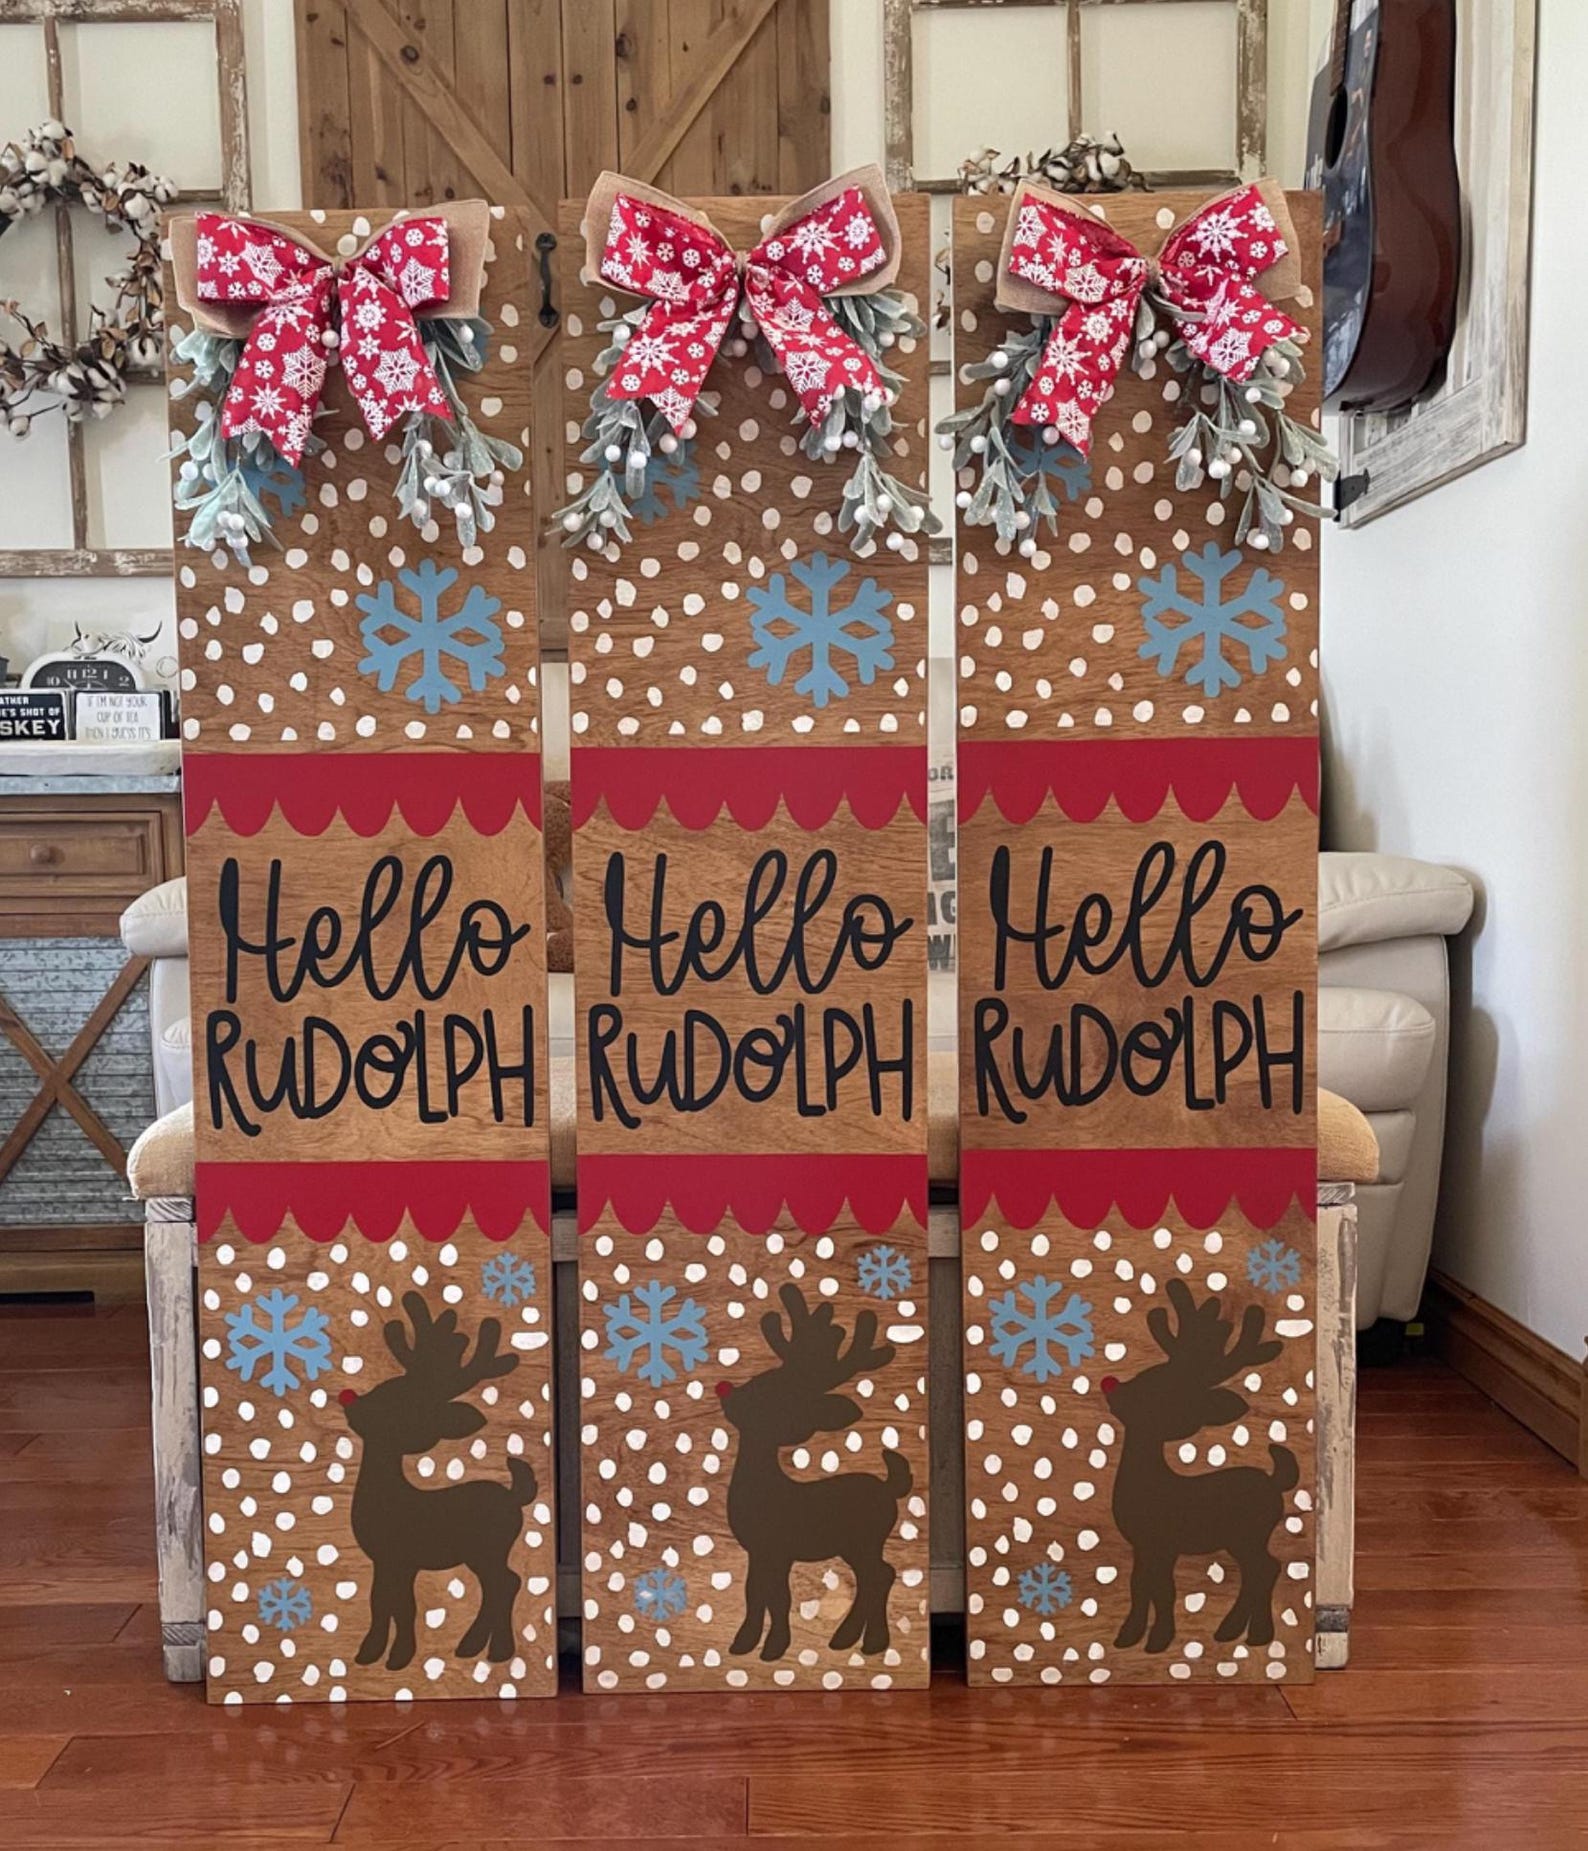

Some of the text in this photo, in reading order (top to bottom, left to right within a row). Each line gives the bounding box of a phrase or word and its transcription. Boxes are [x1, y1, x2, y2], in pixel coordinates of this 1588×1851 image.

[20, 707, 44, 717] SHOT
[48, 707, 60, 717] OF
[67, 669, 77, 679] 11
[82, 668, 97, 679] 12
[0, 720, 61, 736] SKEY
[219, 855, 530, 1004] Hello
[604, 849, 913, 997] Hello
[990, 841, 1303, 991] Hello
